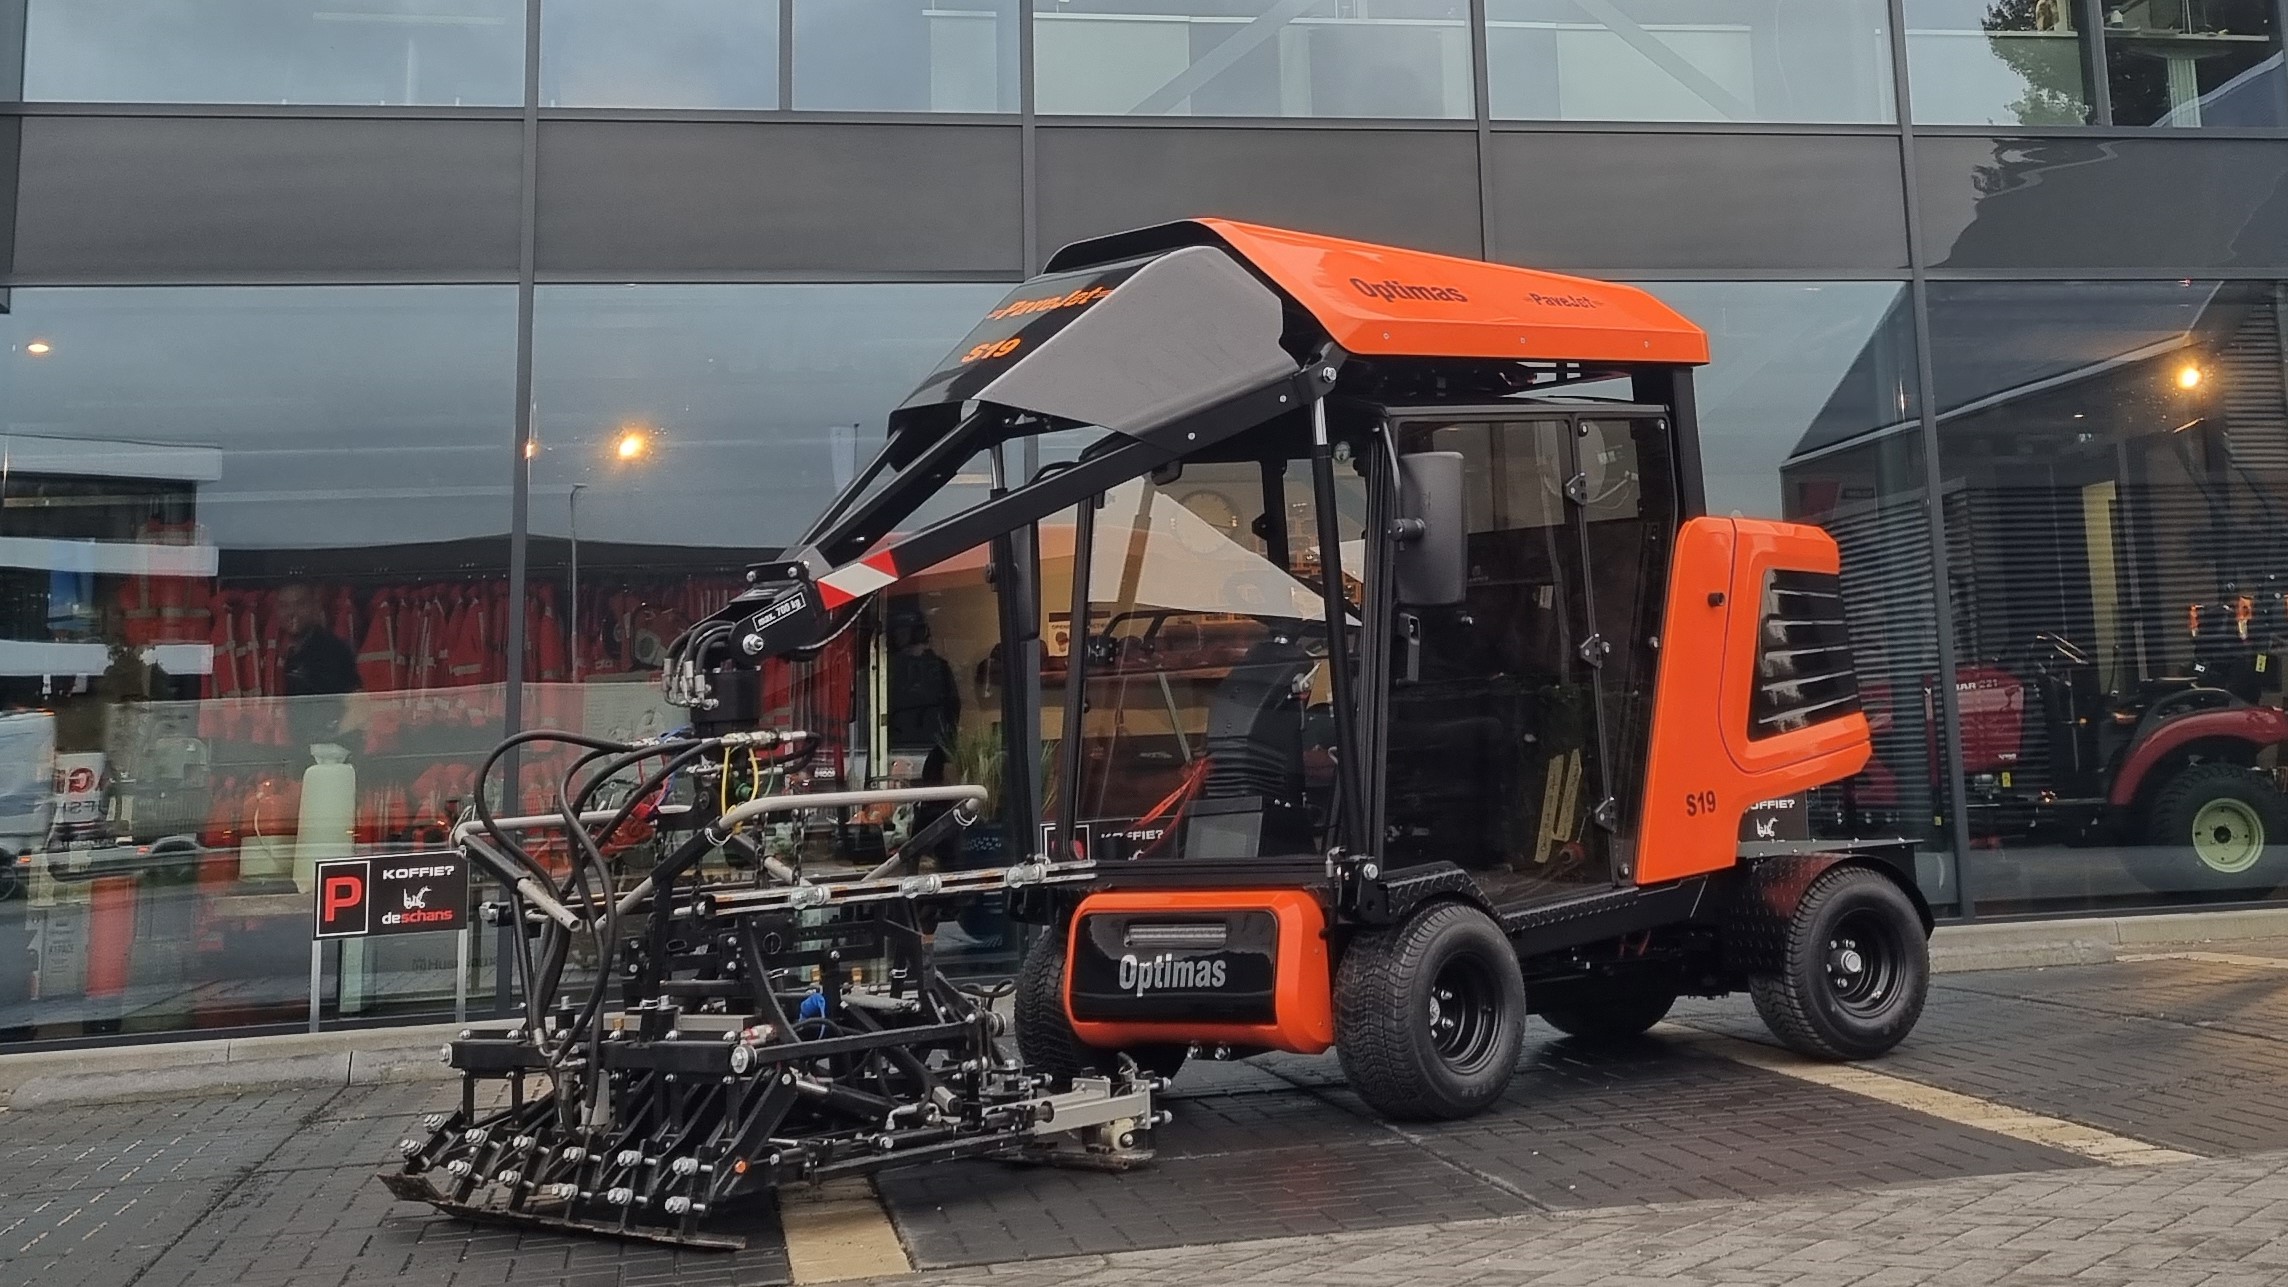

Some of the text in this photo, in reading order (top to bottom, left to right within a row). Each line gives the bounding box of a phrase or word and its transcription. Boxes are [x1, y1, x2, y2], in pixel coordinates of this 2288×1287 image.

[1350, 278, 1467, 303] Optimas
[961, 338, 1021, 364] S19
[757, 598, 802, 627] max. 700 kg
[1685, 790, 1716, 817] S19
[382, 865, 455, 880] KOFFIE?
[324, 876, 362, 922] P
[381, 909, 453, 925] deschans
[1119, 953, 1226, 997] Optimas
